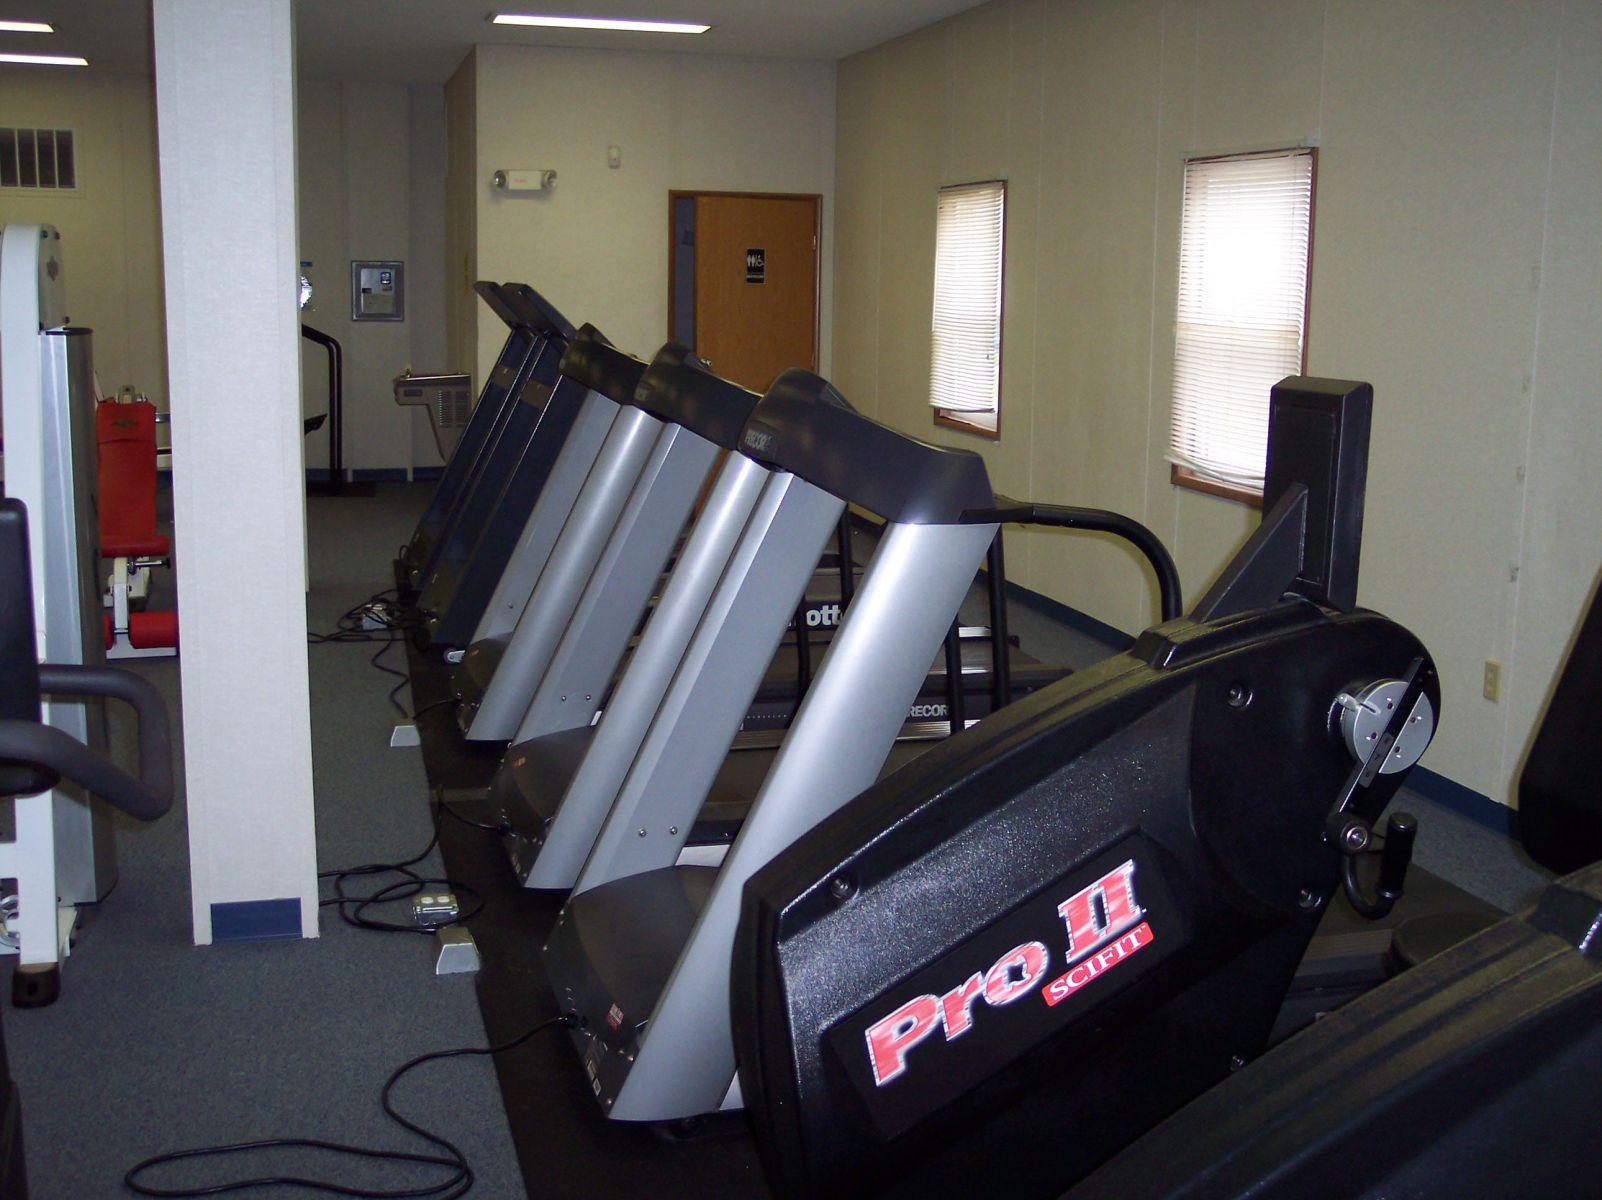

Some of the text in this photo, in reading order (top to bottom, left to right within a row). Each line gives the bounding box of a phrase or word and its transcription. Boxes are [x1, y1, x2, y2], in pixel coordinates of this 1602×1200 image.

[805, 604, 842, 627] ott
[907, 703, 949, 718] RECOR
[1049, 926, 1145, 1001] SCIFIT
[864, 940, 1049, 1087] Pro
